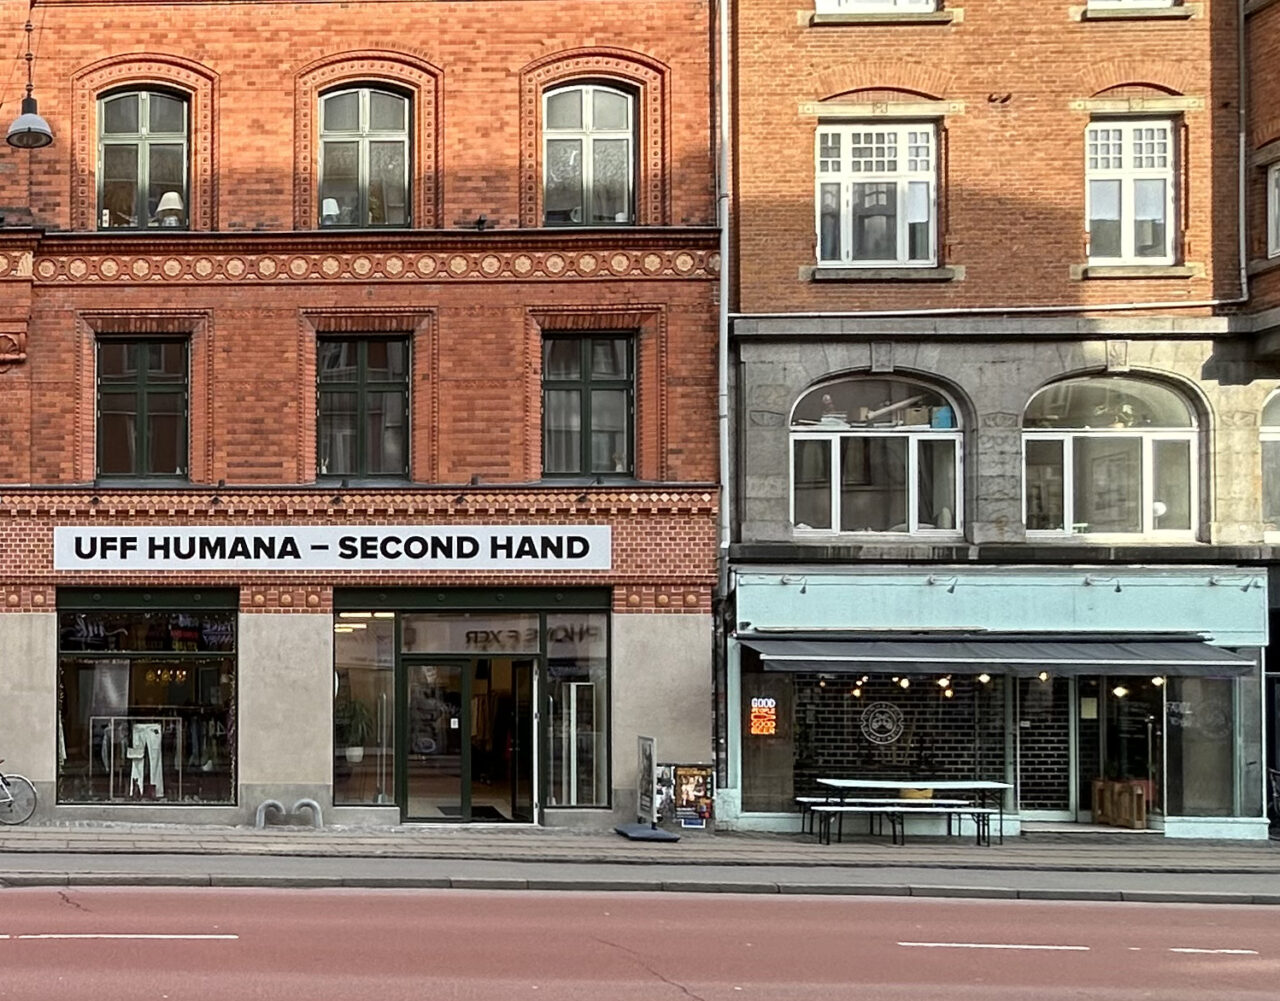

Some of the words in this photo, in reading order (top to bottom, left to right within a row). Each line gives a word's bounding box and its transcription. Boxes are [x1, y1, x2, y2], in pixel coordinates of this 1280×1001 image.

[74, 536, 138, 560] UFF
[147, 536, 302, 560] HUMANA
[338, 536, 480, 560] SECOND
[489, 536, 591, 560] HAND
[751, 697, 776, 708] GOOD
